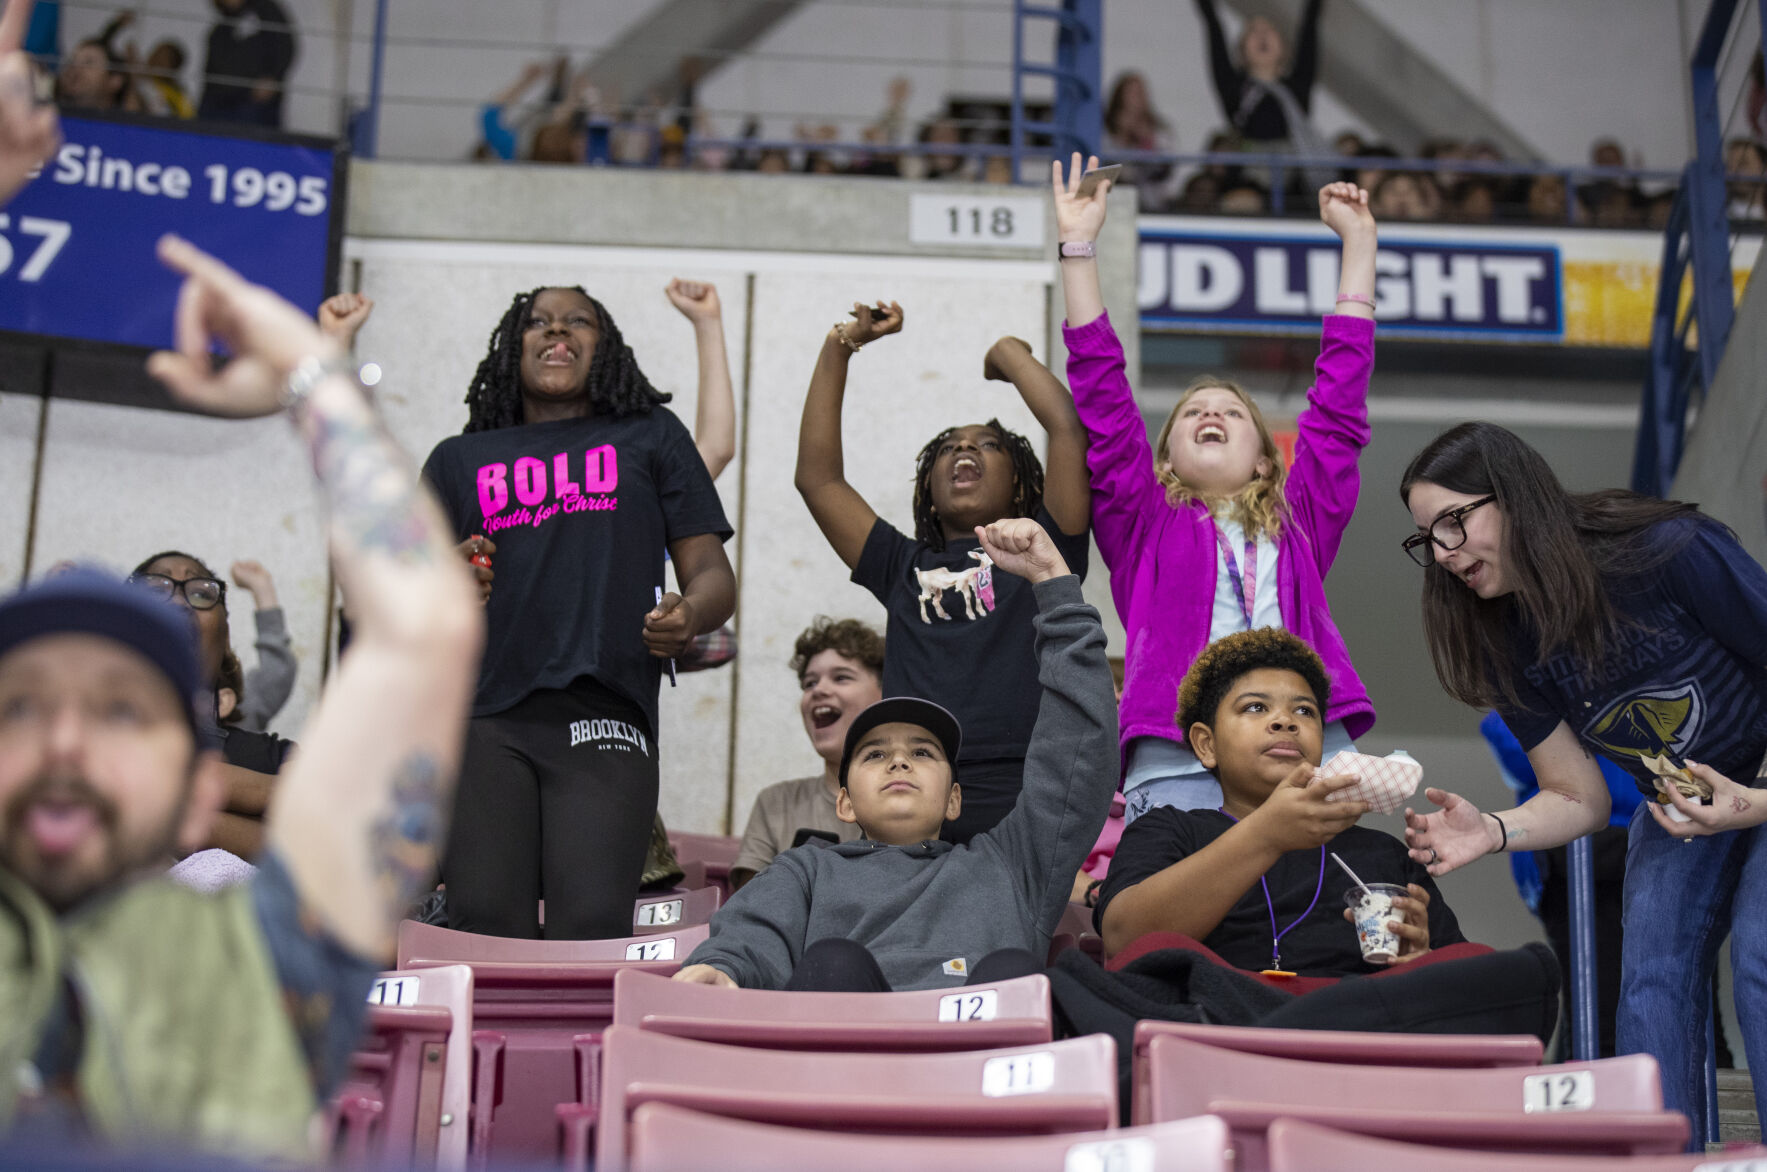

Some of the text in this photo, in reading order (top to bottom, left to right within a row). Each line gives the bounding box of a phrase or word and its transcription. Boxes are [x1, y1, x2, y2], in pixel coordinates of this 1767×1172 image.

[54, 143, 327, 216] Since 1995
[946, 206, 1014, 237] 118
[477, 444, 618, 518] BOLD
[483, 494, 618, 535] Youth for Christ
[1555, 630, 1685, 699] TINGRAYS
[569, 718, 648, 757] BROOKLYN
[649, 903, 672, 924] 13
[637, 944, 661, 960] 12
[376, 981, 403, 1004] 11
[954, 996, 984, 1022] 12
[1006, 1060, 1033, 1088] 11
[1541, 1076, 1577, 1107] 12
